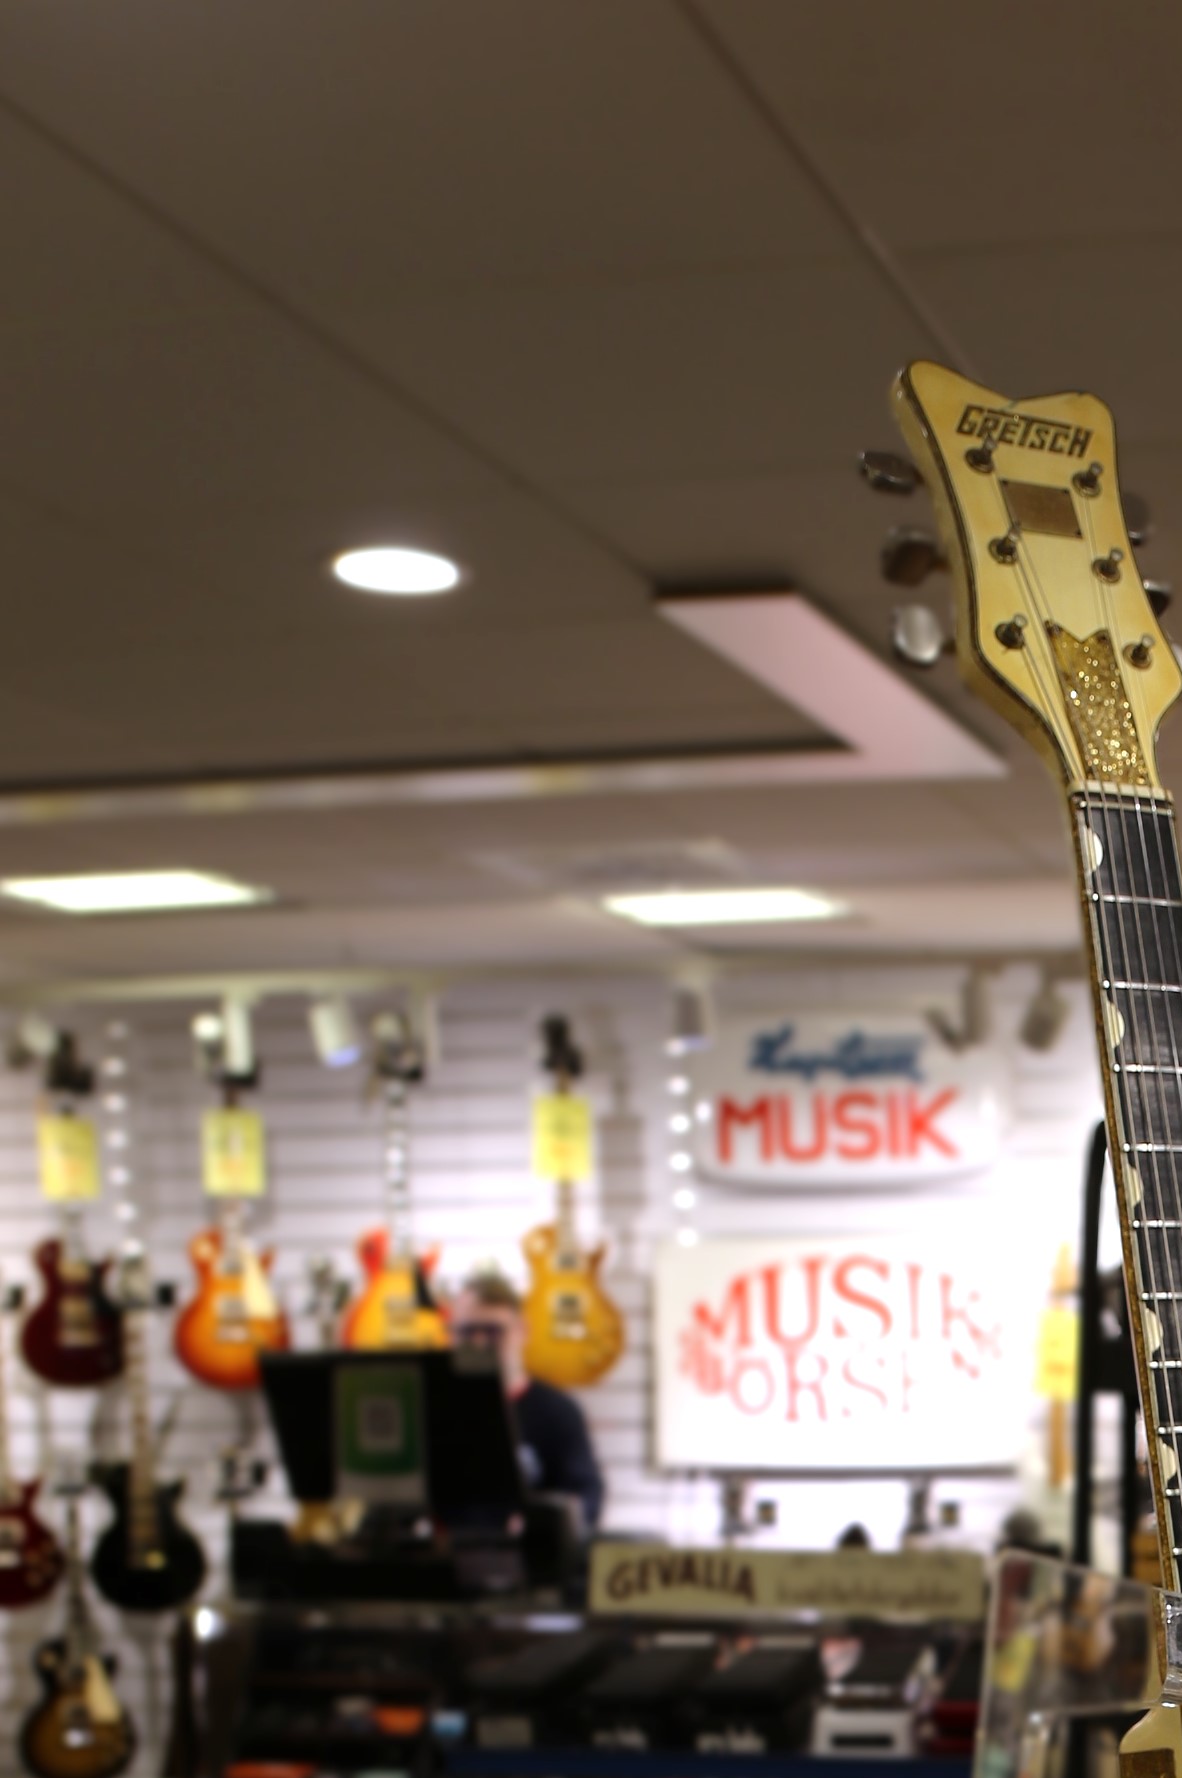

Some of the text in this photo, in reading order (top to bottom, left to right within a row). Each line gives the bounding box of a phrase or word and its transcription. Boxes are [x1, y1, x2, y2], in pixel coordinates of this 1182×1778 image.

[956, 404, 1094, 459] GRETSCH
[717, 1086, 959, 1167] MUSIK
[690, 1252, 1002, 1357] MUSIK
